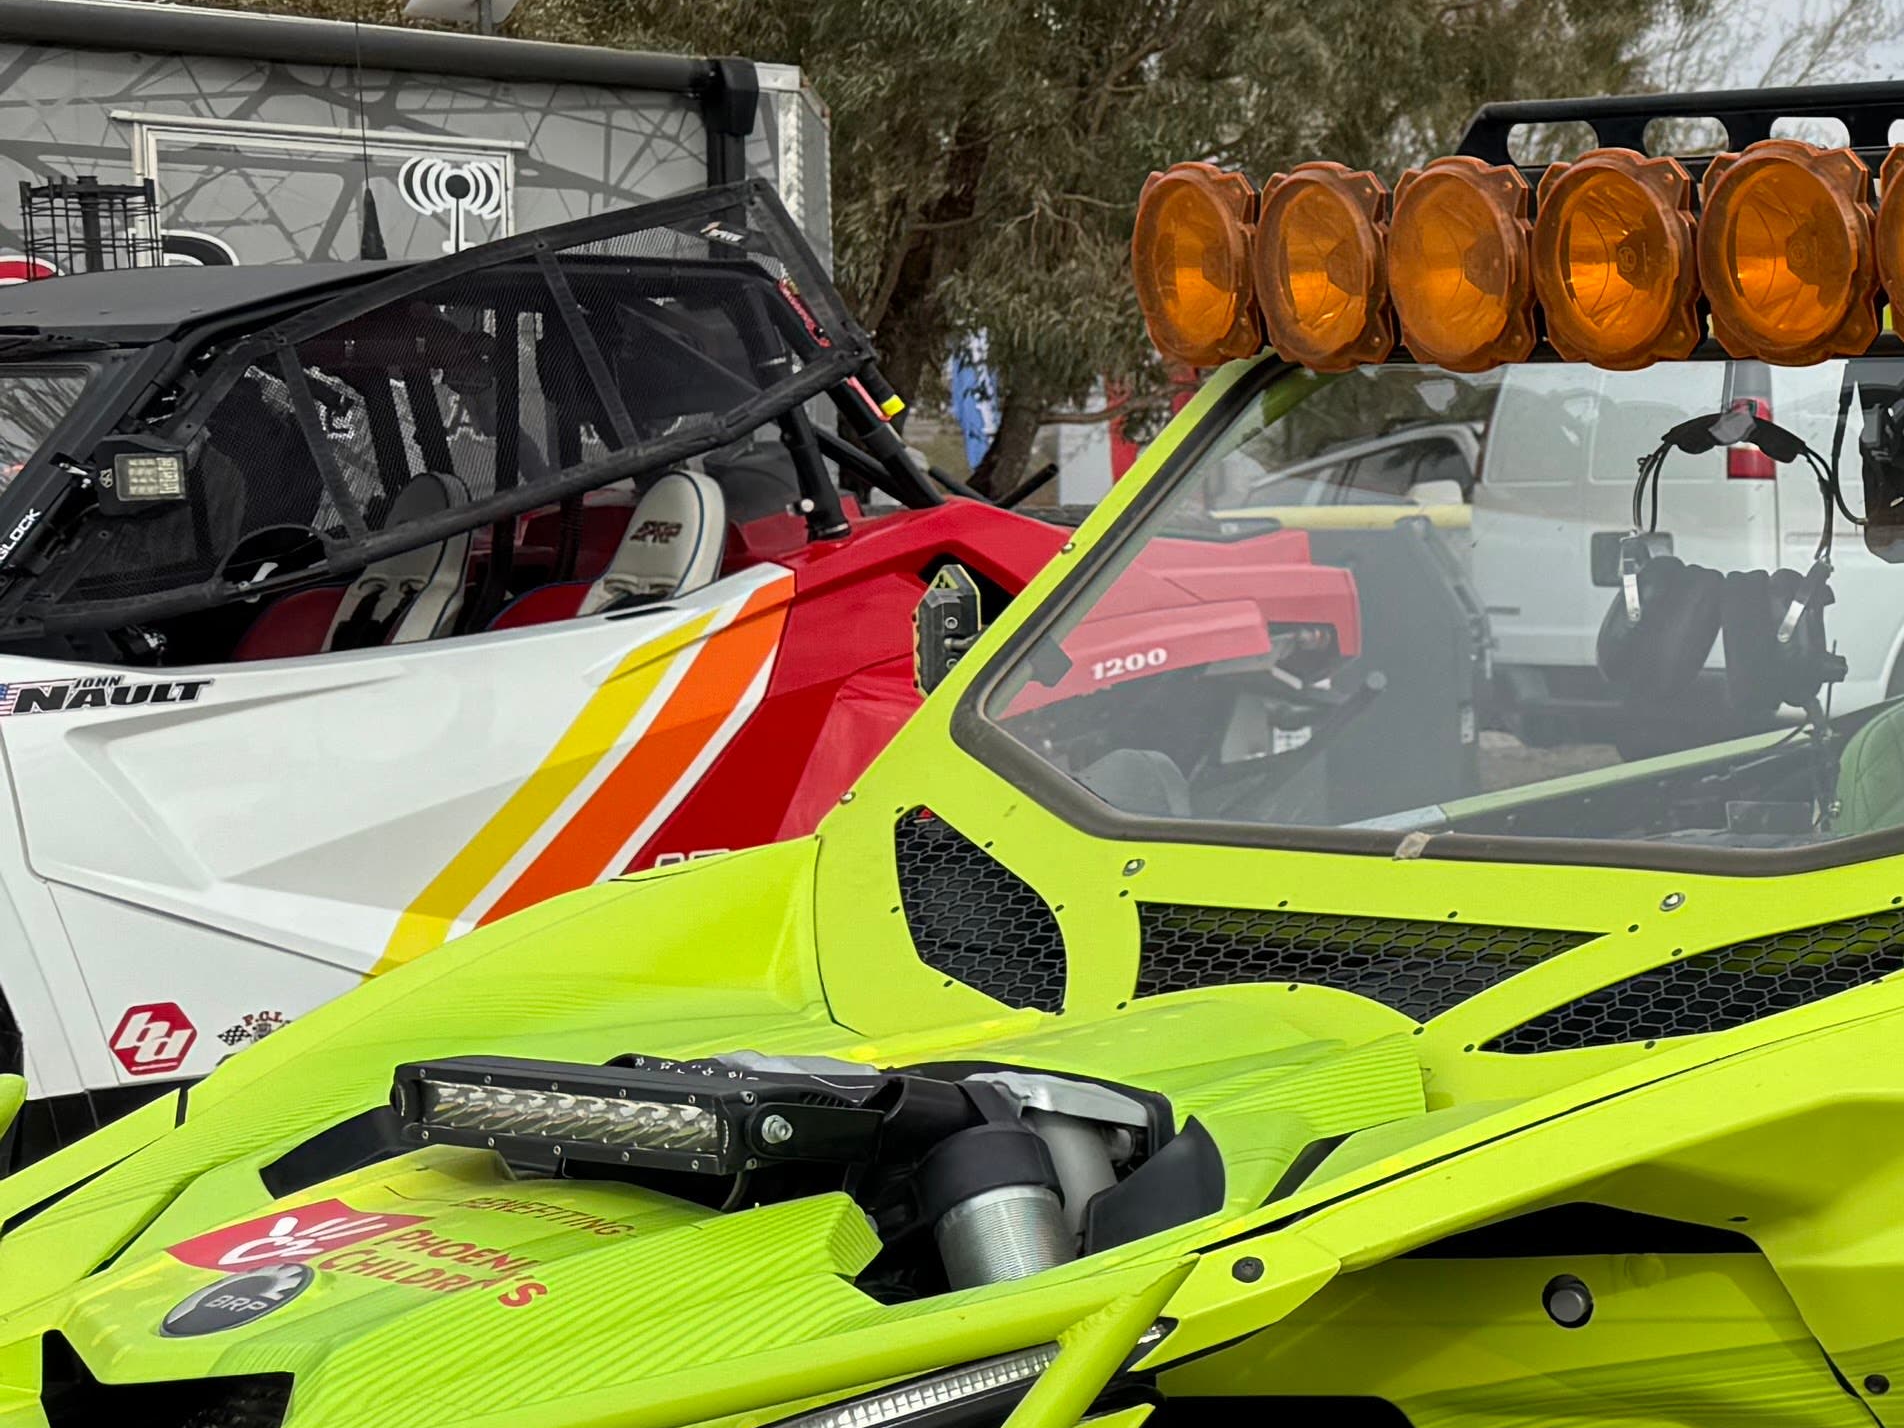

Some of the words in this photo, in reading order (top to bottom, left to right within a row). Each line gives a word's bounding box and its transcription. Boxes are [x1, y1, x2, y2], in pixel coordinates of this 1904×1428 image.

[1092, 647, 1168, 681] 1200
[12, 679, 214, 715] NAULT
[371, 1228, 542, 1274] PHOENI
[206, 1293, 269, 1314] BRP
